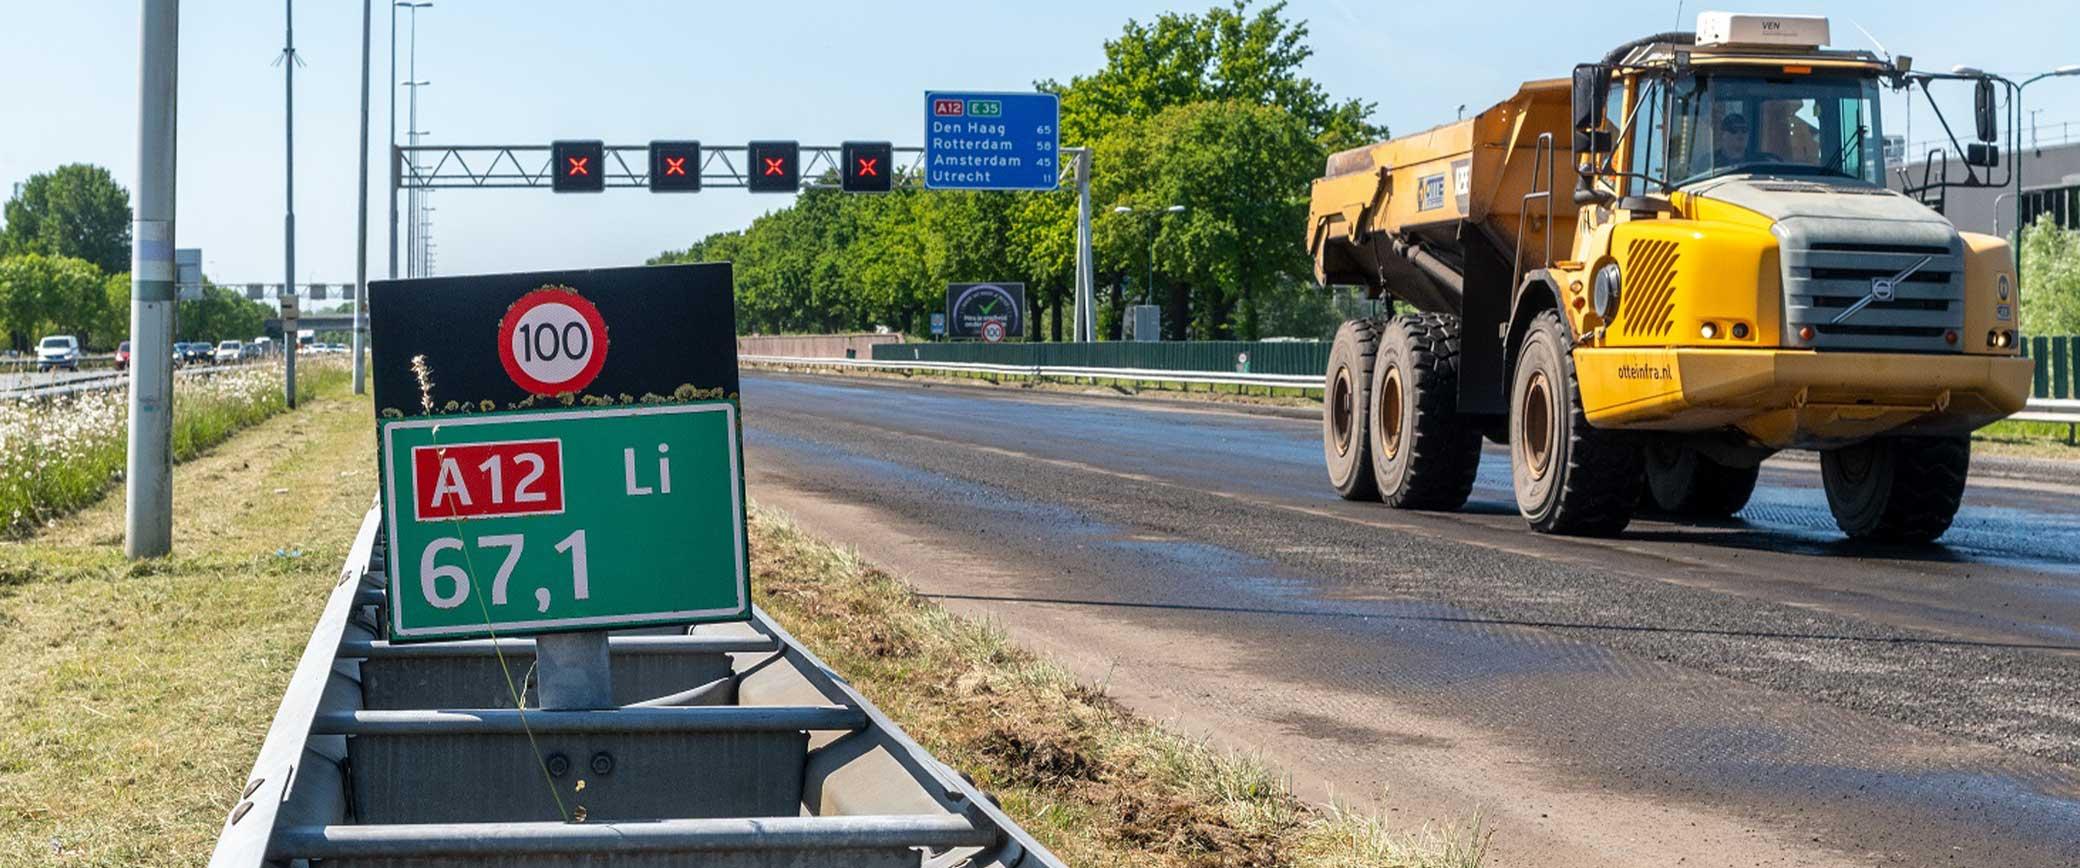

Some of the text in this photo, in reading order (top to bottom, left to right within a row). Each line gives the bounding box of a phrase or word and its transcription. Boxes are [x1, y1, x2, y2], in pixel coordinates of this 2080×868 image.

[1762, 21, 1780, 30] VEN
[937, 103, 961, 113] A12
[933, 122, 1051, 136] Den Haag 65
[933, 138, 1051, 151] Rotterdam 58
[933, 154, 1051, 167] Amsterdam 45
[933, 170, 1051, 183] Utrecht 11
[519, 321, 588, 363] 100
[1618, 363, 1672, 380] otteinfra.nl
[431, 442, 671, 508] A12 Li
[420, 529, 590, 613] 67,1
